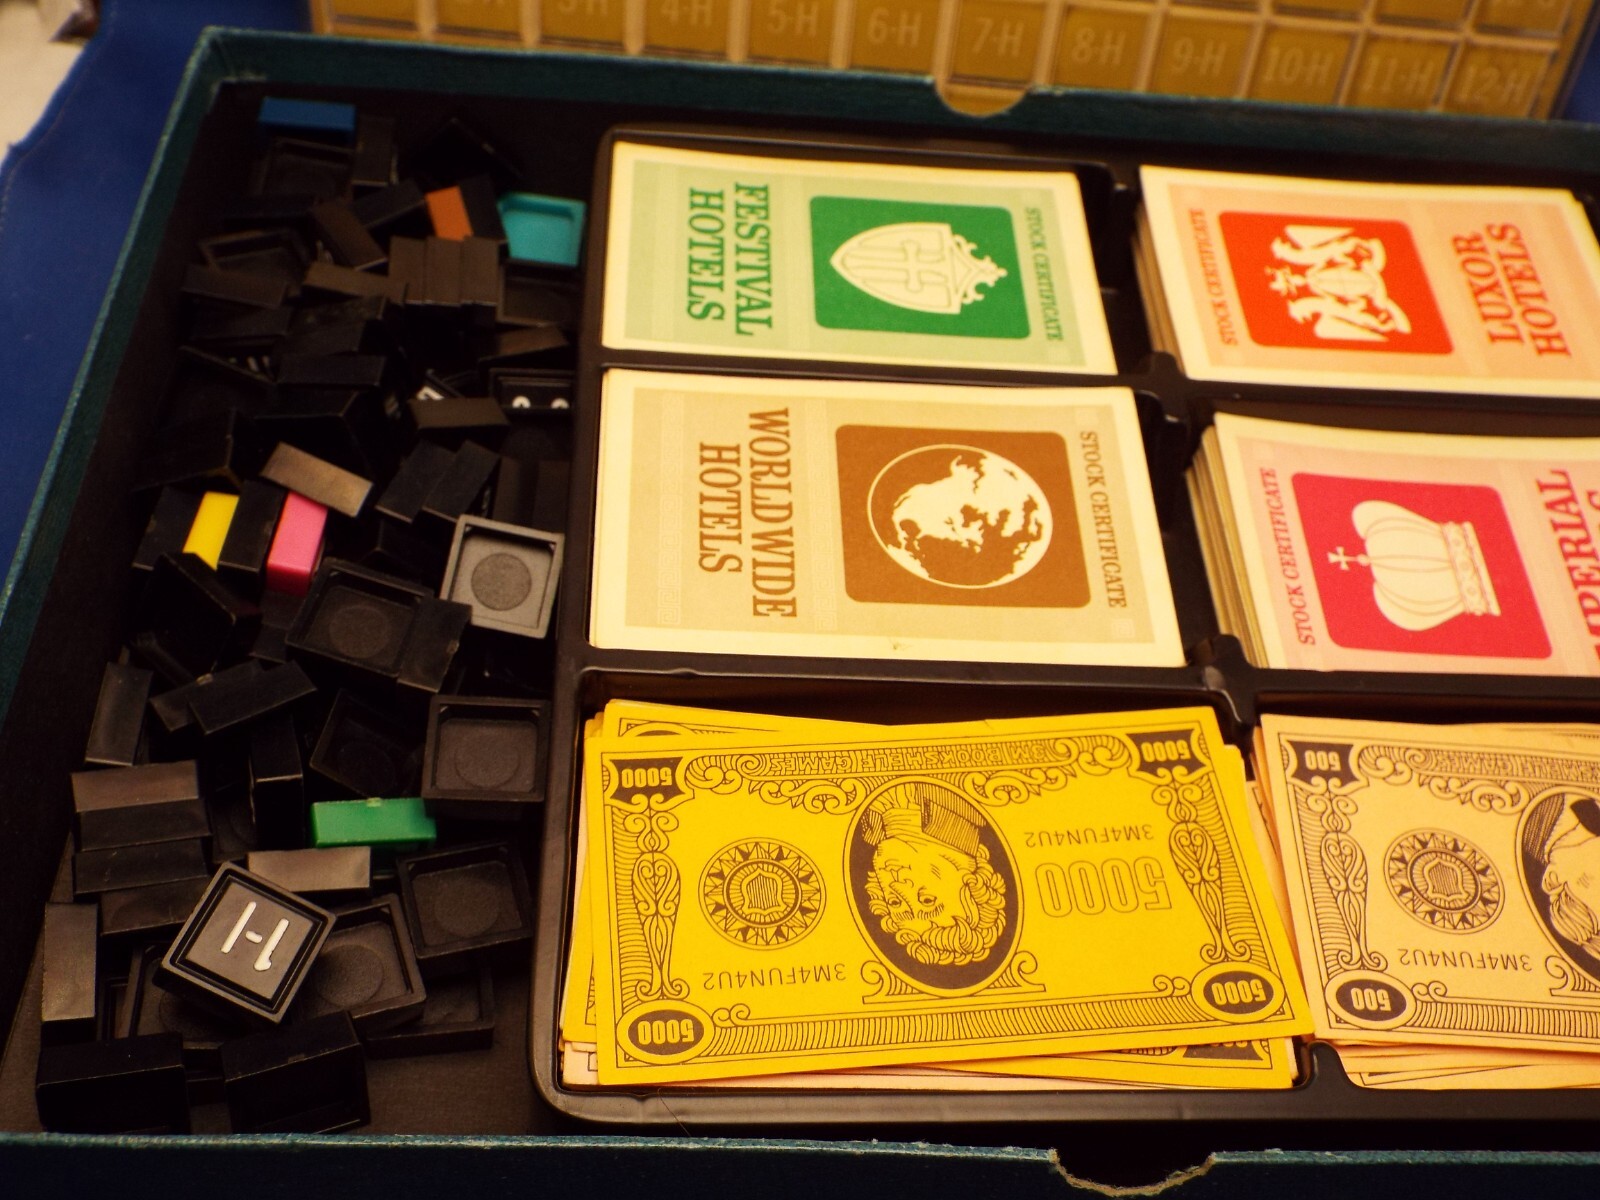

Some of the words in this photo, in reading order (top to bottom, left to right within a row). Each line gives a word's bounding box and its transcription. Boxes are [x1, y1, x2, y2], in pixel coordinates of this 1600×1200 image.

[767, 0, 820, 38] 5-H
[867, 7, 923, 47] 6-H
[972, 17, 1025, 58] 7-H
[1070, 27, 1126, 66] 8-H
[1171, 36, 1227, 78] 9-H
[1263, 45, 1334, 86] 10-H
[1361, 54, 1436, 97] 11-H
[1025, 207, 1047, 250] STOCK
[686, 187, 725, 320] HOTELS
[734, 182, 772, 336] FESTIVAL
[1033, 253, 1063, 341] CERTIFICATE
[1452, 232, 1526, 345] LUXOR
[1484, 224, 1572, 357] HOTELS
[1211, 299, 1238, 346] STOCK
[1080, 430, 1105, 487] STOCK
[699, 442, 743, 573] HOTELS
[749, 407, 797, 618] WORLDWIDE
[1260, 467, 1300, 580] CERTIFICATE
[1091, 491, 1127, 608] CERTIFICATE
[1536, 469, 1600, 662] PERIAL
[1282, 583, 1315, 646] STOCK
[770, 753, 850, 773] GAMES
[1141, 739, 1192, 762] 5000
[1304, 750, 1342, 772] 500
[621, 766, 673, 788] 5000
[1024, 823, 1154, 849] 3M4FUN4U2
[1034, 856, 1173, 918] 5000
[702, 962, 847, 991] 3M4FUN4U2
[1397, 947, 1534, 973] 3M4FUN4U2
[1211, 978, 1267, 1006] 5000
[1350, 986, 1393, 1012] 500
[636, 1018, 695, 1045] 5000
